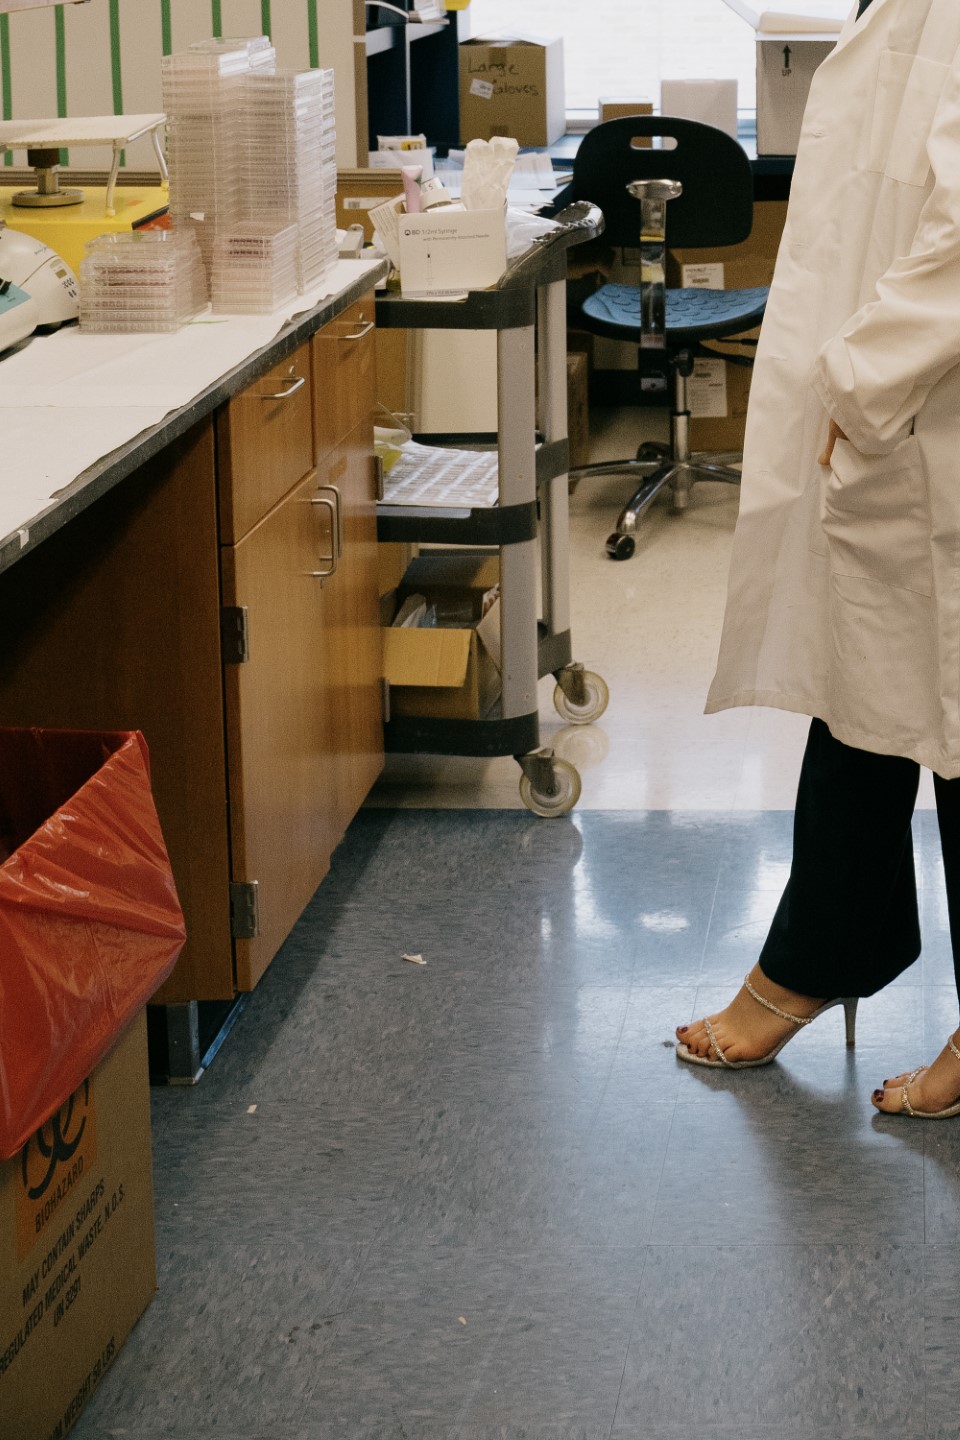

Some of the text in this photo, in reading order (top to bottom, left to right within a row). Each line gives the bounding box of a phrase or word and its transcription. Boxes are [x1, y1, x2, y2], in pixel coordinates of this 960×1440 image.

[35, 1155, 84, 1234] BIOHAZARD
[22, 1178, 105, 1308] MAY CONTAIN SHARPS
[0, 1300, 44, 1376] REGULATED
[44, 1253, 77, 1312] MEDICAL
[77, 1214, 103, 1261] WASTE
[54, 1298, 65, 1328] UN
[63, 1372, 92, 1428] WEIGHT
[102, 1335, 115, 1369] LBS
